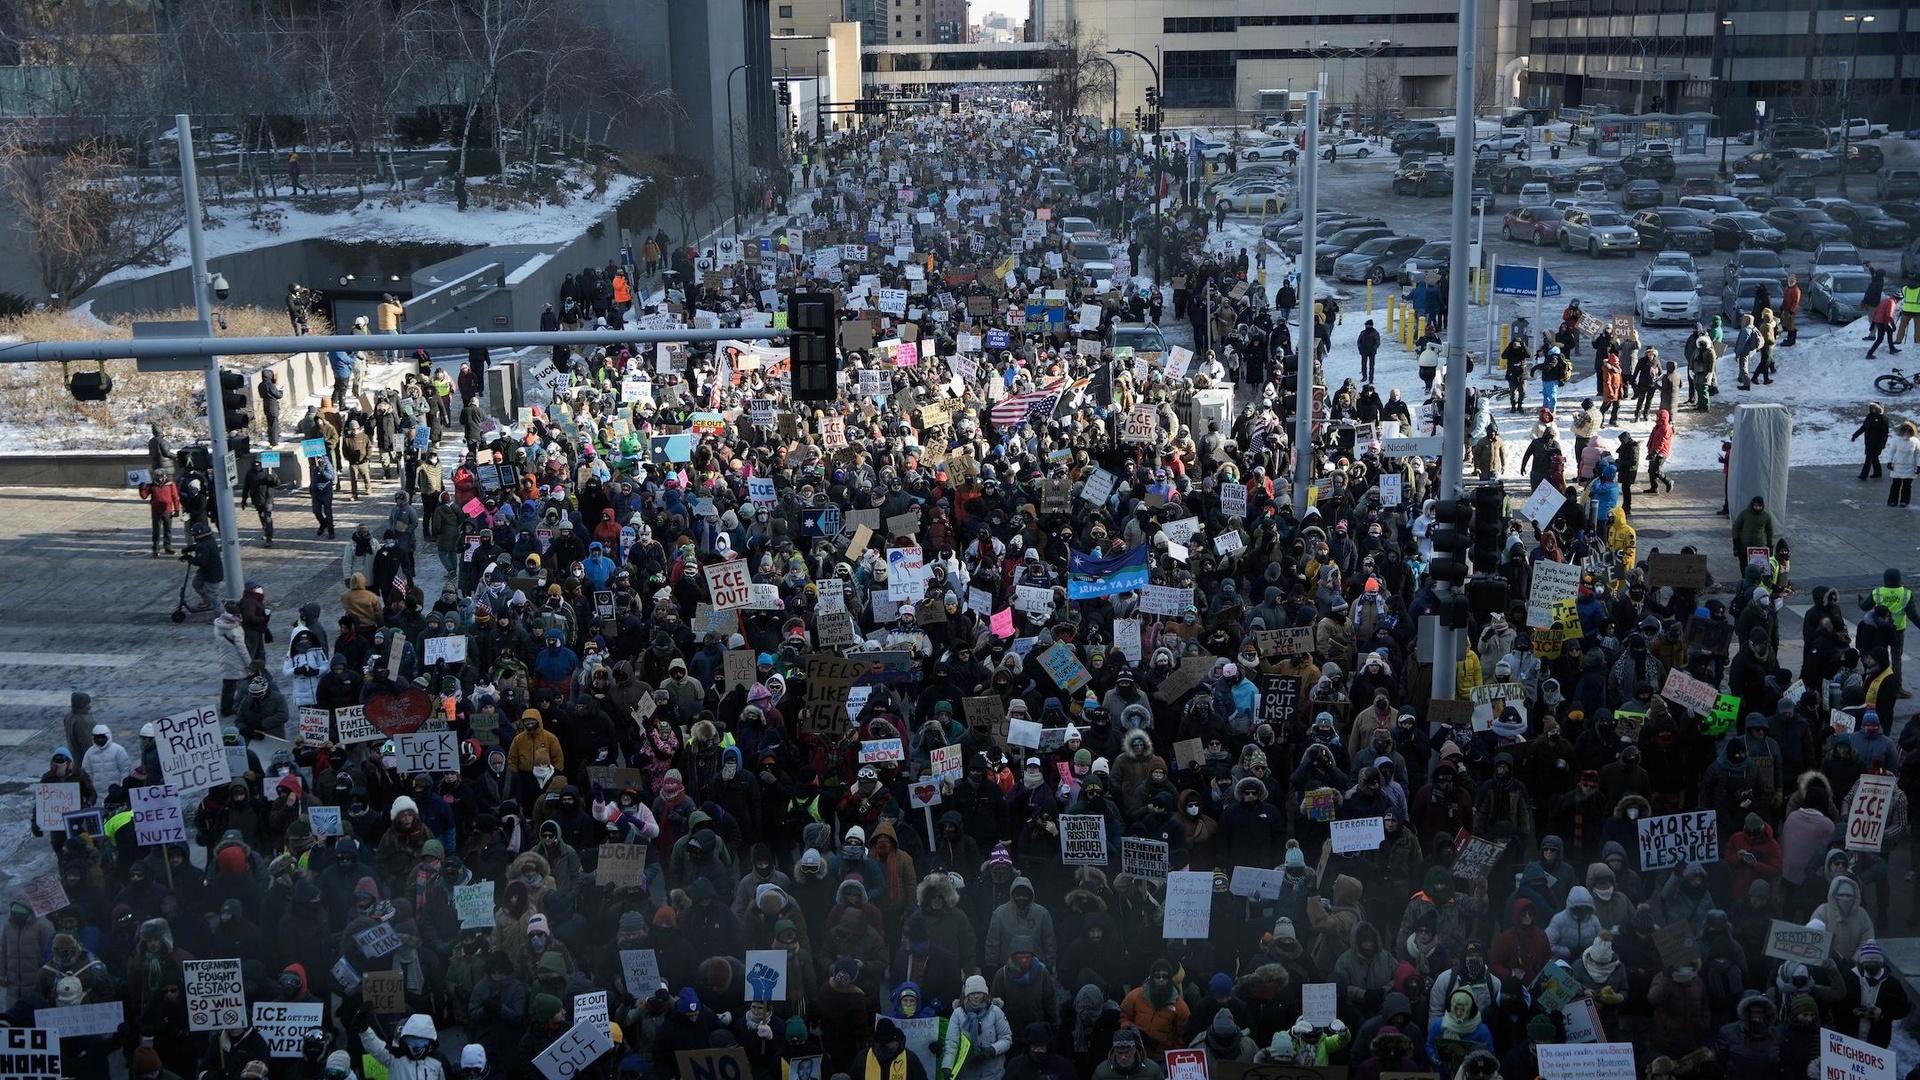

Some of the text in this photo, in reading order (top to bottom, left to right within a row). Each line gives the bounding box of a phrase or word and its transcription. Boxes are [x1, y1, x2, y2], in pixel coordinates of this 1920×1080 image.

[881, 290, 895, 299] ICE
[534, 365, 557, 381] FUCK
[752, 400, 771, 411] STOP
[1130, 414, 1151, 425] ICE
[824, 422, 841, 434] ICE
[1128, 424, 1152, 437] OUT!
[826, 434, 844, 445] OUT!
[1386, 443, 1417, 452] Nicollet
[1383, 476, 1399, 486] ICE
[751, 483, 774, 496] ICE
[825, 509, 838, 521] ICE
[825, 522, 839, 535] OUT
[712, 571, 745, 590] ICE
[1110, 581, 1124, 590] YA
[716, 587, 749, 606] OUT!
[822, 613, 846, 623] FIGHT
[1553, 603, 1577, 622] ICE
[1270, 630, 1288, 641] LIKE
[729, 654, 755, 671] FUCK
[808, 659, 865, 680] FEELS
[733, 670, 752, 681] ICE
[809, 682, 849, 702] LIKE
[1268, 678, 1297, 692] ICE
[1266, 693, 1298, 706] OUT
[1264, 706, 1295, 721] MSP
[156, 707, 218, 738] Purple
[168, 731, 214, 755] Rain
[189, 745, 223, 763] melt
[862, 750, 900, 762] NOW
[932, 750, 945, 763] NO
[406, 752, 451, 772] ICE
[172, 760, 224, 792] ICE
[41, 786, 74, 802] Bring
[136, 785, 179, 802] I.C.E.
[1854, 795, 1886, 820] ICE
[1064, 821, 1100, 832] JONATHAN
[1334, 819, 1379, 830] TERRORIZE
[1649, 812, 1708, 837] MORE
[1849, 817, 1881, 843] OUT!
[139, 826, 184, 845] NUTZ
[1067, 831, 1100, 841] ROSS FOR
[1672, 831, 1712, 848] DISH
[1066, 840, 1102, 853] MURDER
[1123, 841, 1166, 853] GENERAL
[1645, 842, 1717, 868] LESS ICE
[1123, 868, 1167, 879] JUSTICE
[186, 960, 240, 973] MY GRANDPA
[198, 971, 237, 982] FOUGHT
[187, 981, 242, 996] GESTAPO
[365, 981, 386, 995] GET
[190, 998, 243, 1011] SO WILL
[375, 995, 395, 1009] ICE
[588, 994, 606, 1005] OUT
[211, 1008, 223, 1027] I
[255, 1006, 288, 1021] ICE
[588, 1013, 607, 1024] OUT
[9, 1029, 48, 1049] GO
[1829, 1032, 1844, 1044] OUR
[547, 1030, 585, 1064] ICE
[557, 1038, 600, 1077] OUT
[1828, 1041, 1885, 1071] NEIGHBORS
[0, 1054, 60, 1075] HOME
[1856, 1063, 1871, 1075] ARE
[1826, 1065, 1847, 1080] NOT
